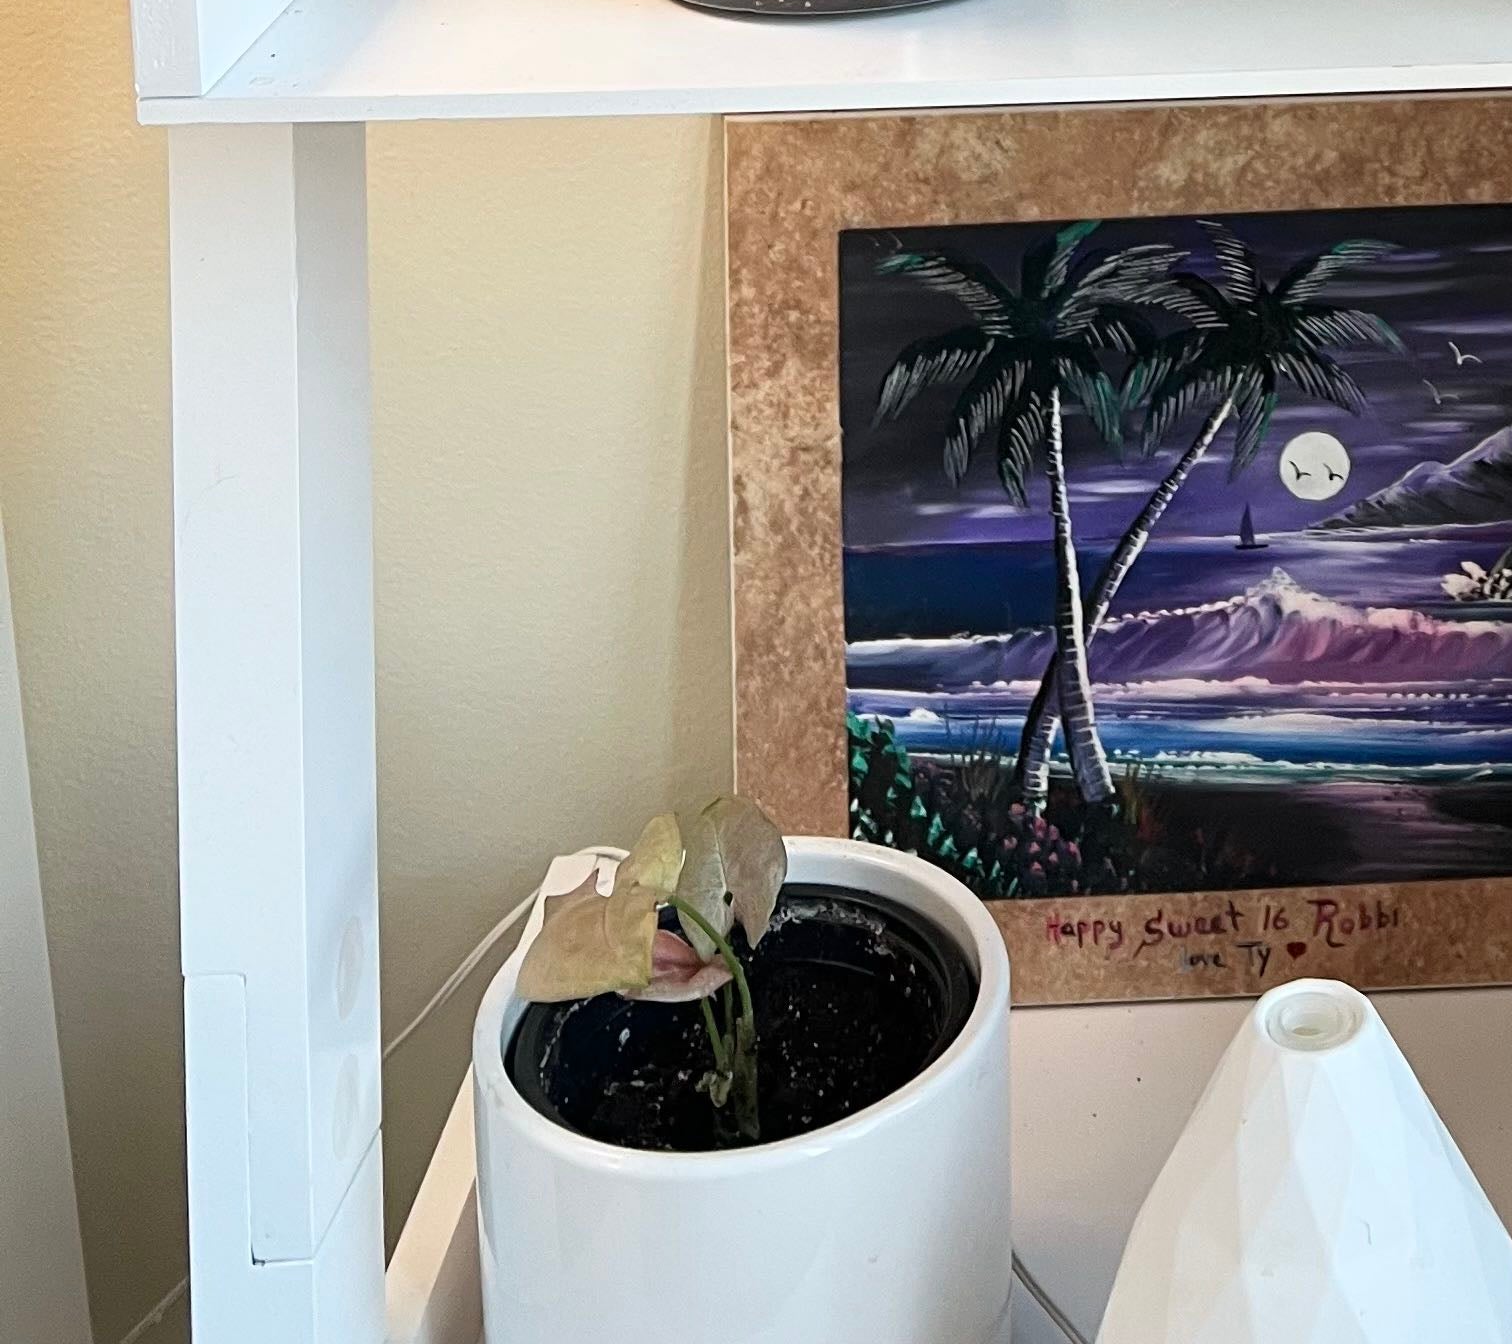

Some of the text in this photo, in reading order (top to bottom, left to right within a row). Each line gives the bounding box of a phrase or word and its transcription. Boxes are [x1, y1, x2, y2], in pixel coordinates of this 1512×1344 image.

[1045, 912, 1125, 953] Happy
[1133, 901, 1243, 959] Sweet
[1262, 904, 1290, 932] 16
[1236, 941, 1271, 978] Ty
